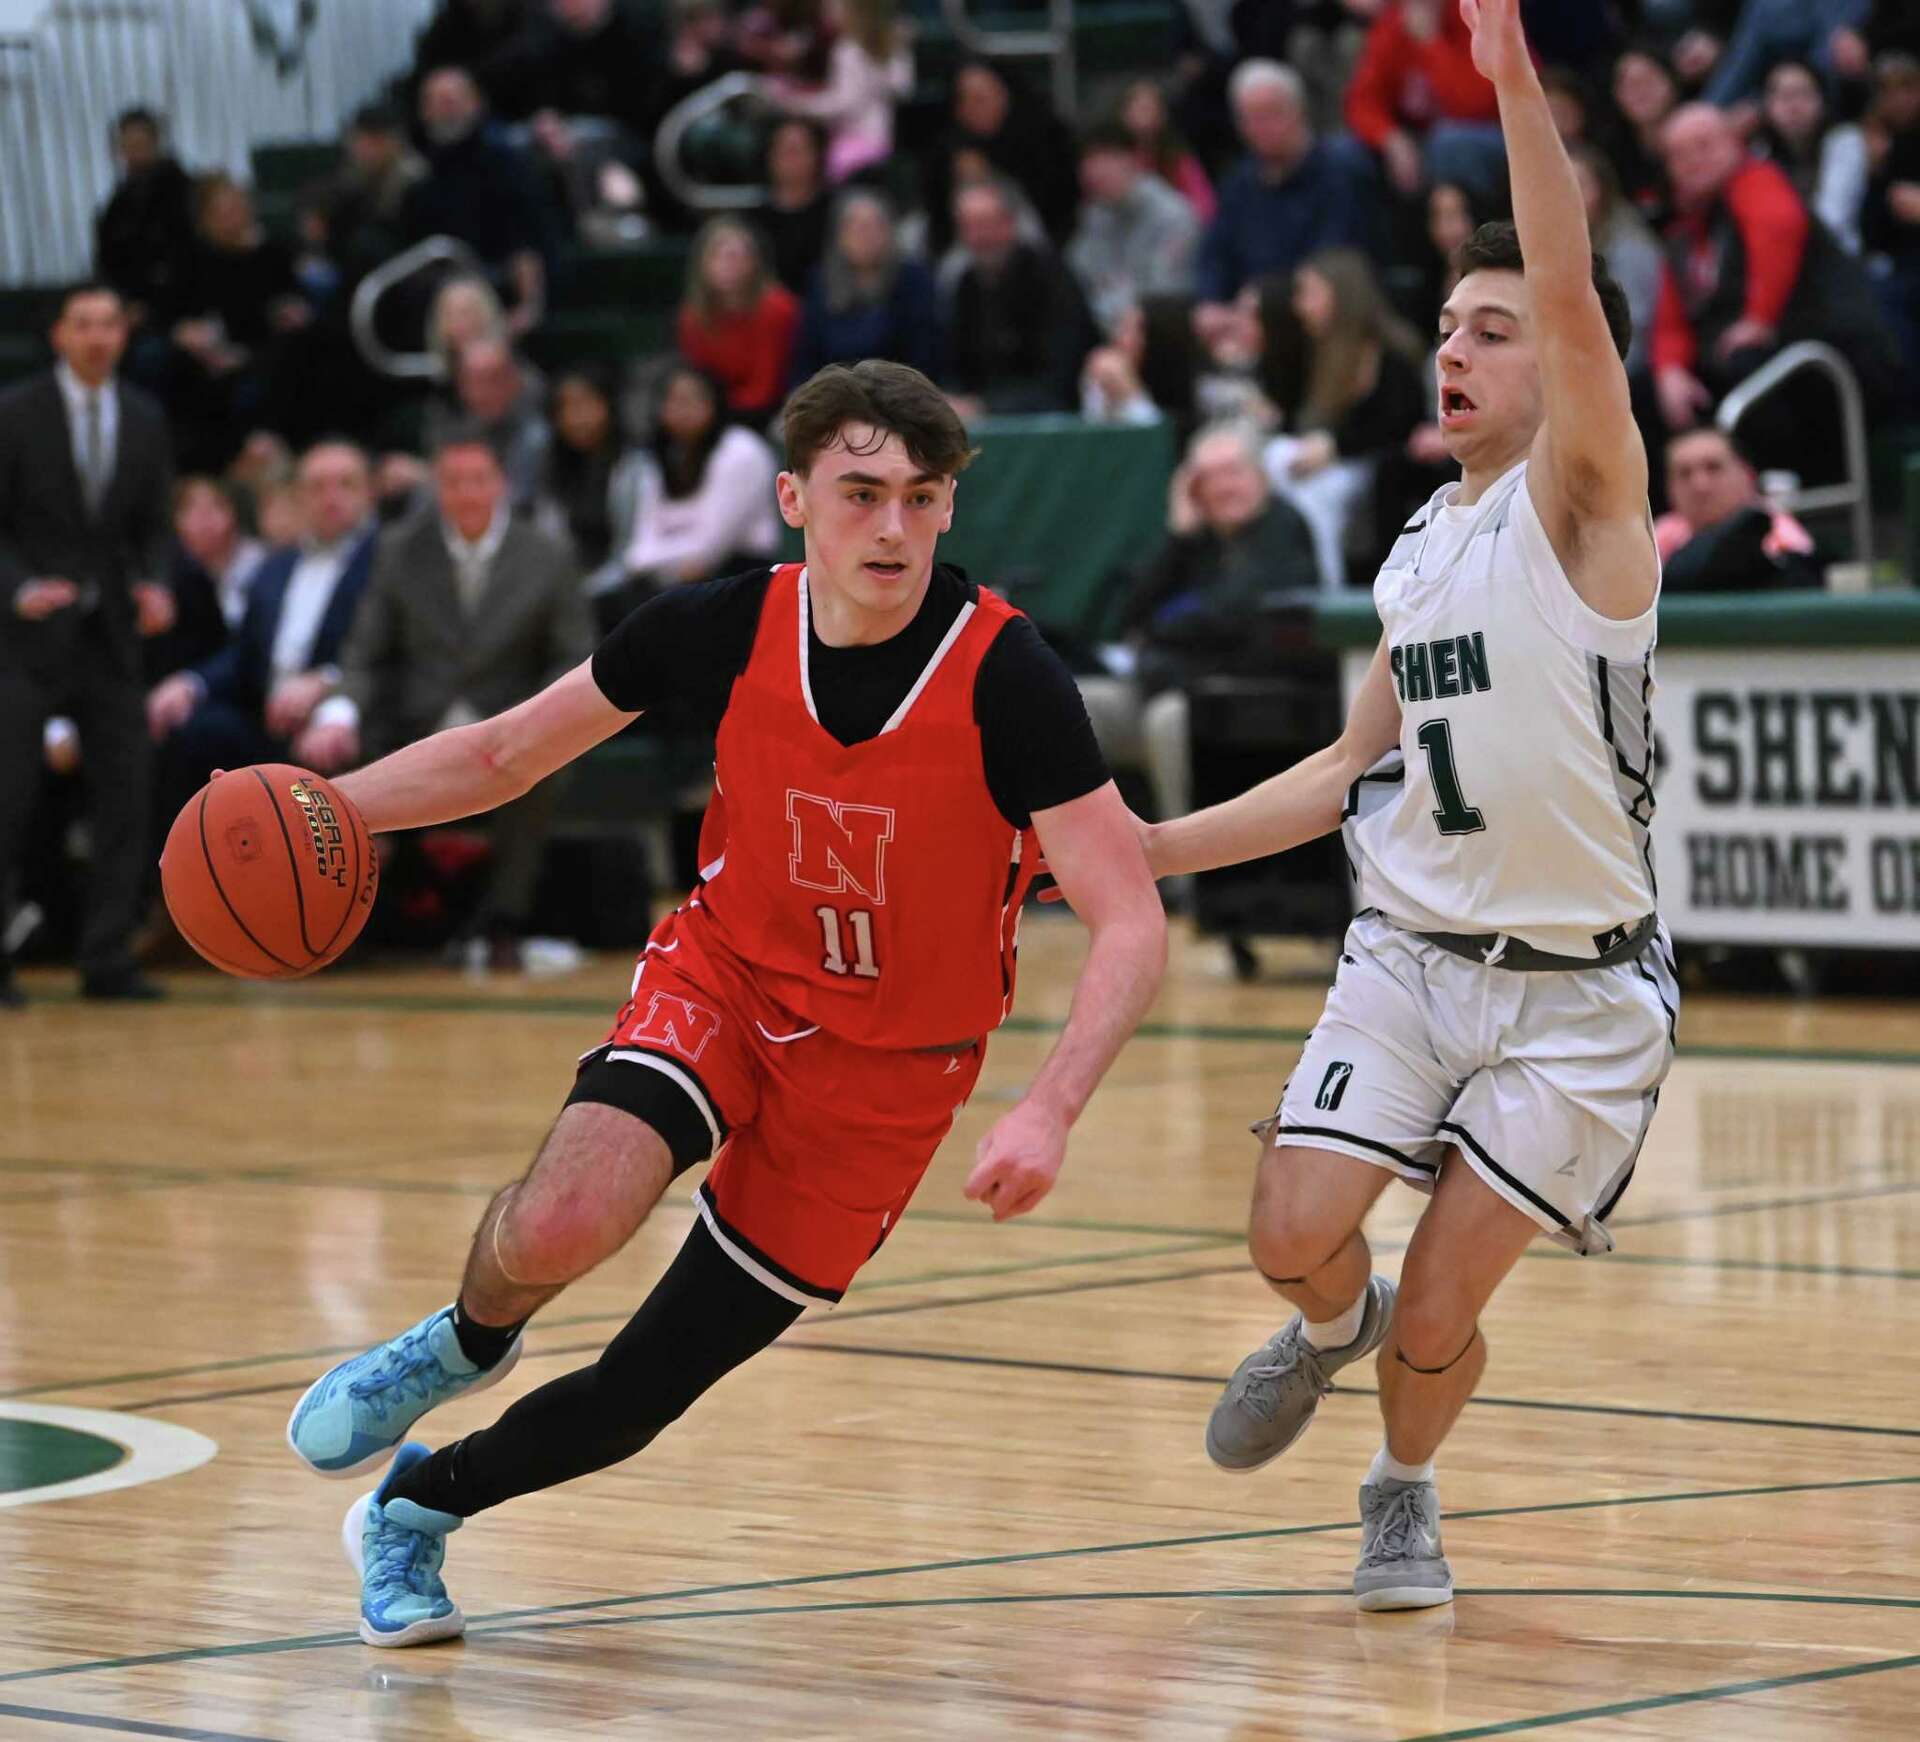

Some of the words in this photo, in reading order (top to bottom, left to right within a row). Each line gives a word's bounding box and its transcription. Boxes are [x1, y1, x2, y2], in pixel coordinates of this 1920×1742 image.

[1391, 631, 1491, 702] SHEN
[1417, 718, 1486, 835] 1
[1693, 690, 1920, 808] SHEN
[299, 777, 346, 888] LEGACY
[786, 788, 895, 904] N
[1686, 834, 1849, 909] HOME
[814, 904, 880, 978] 11
[630, 990, 721, 1063] N
